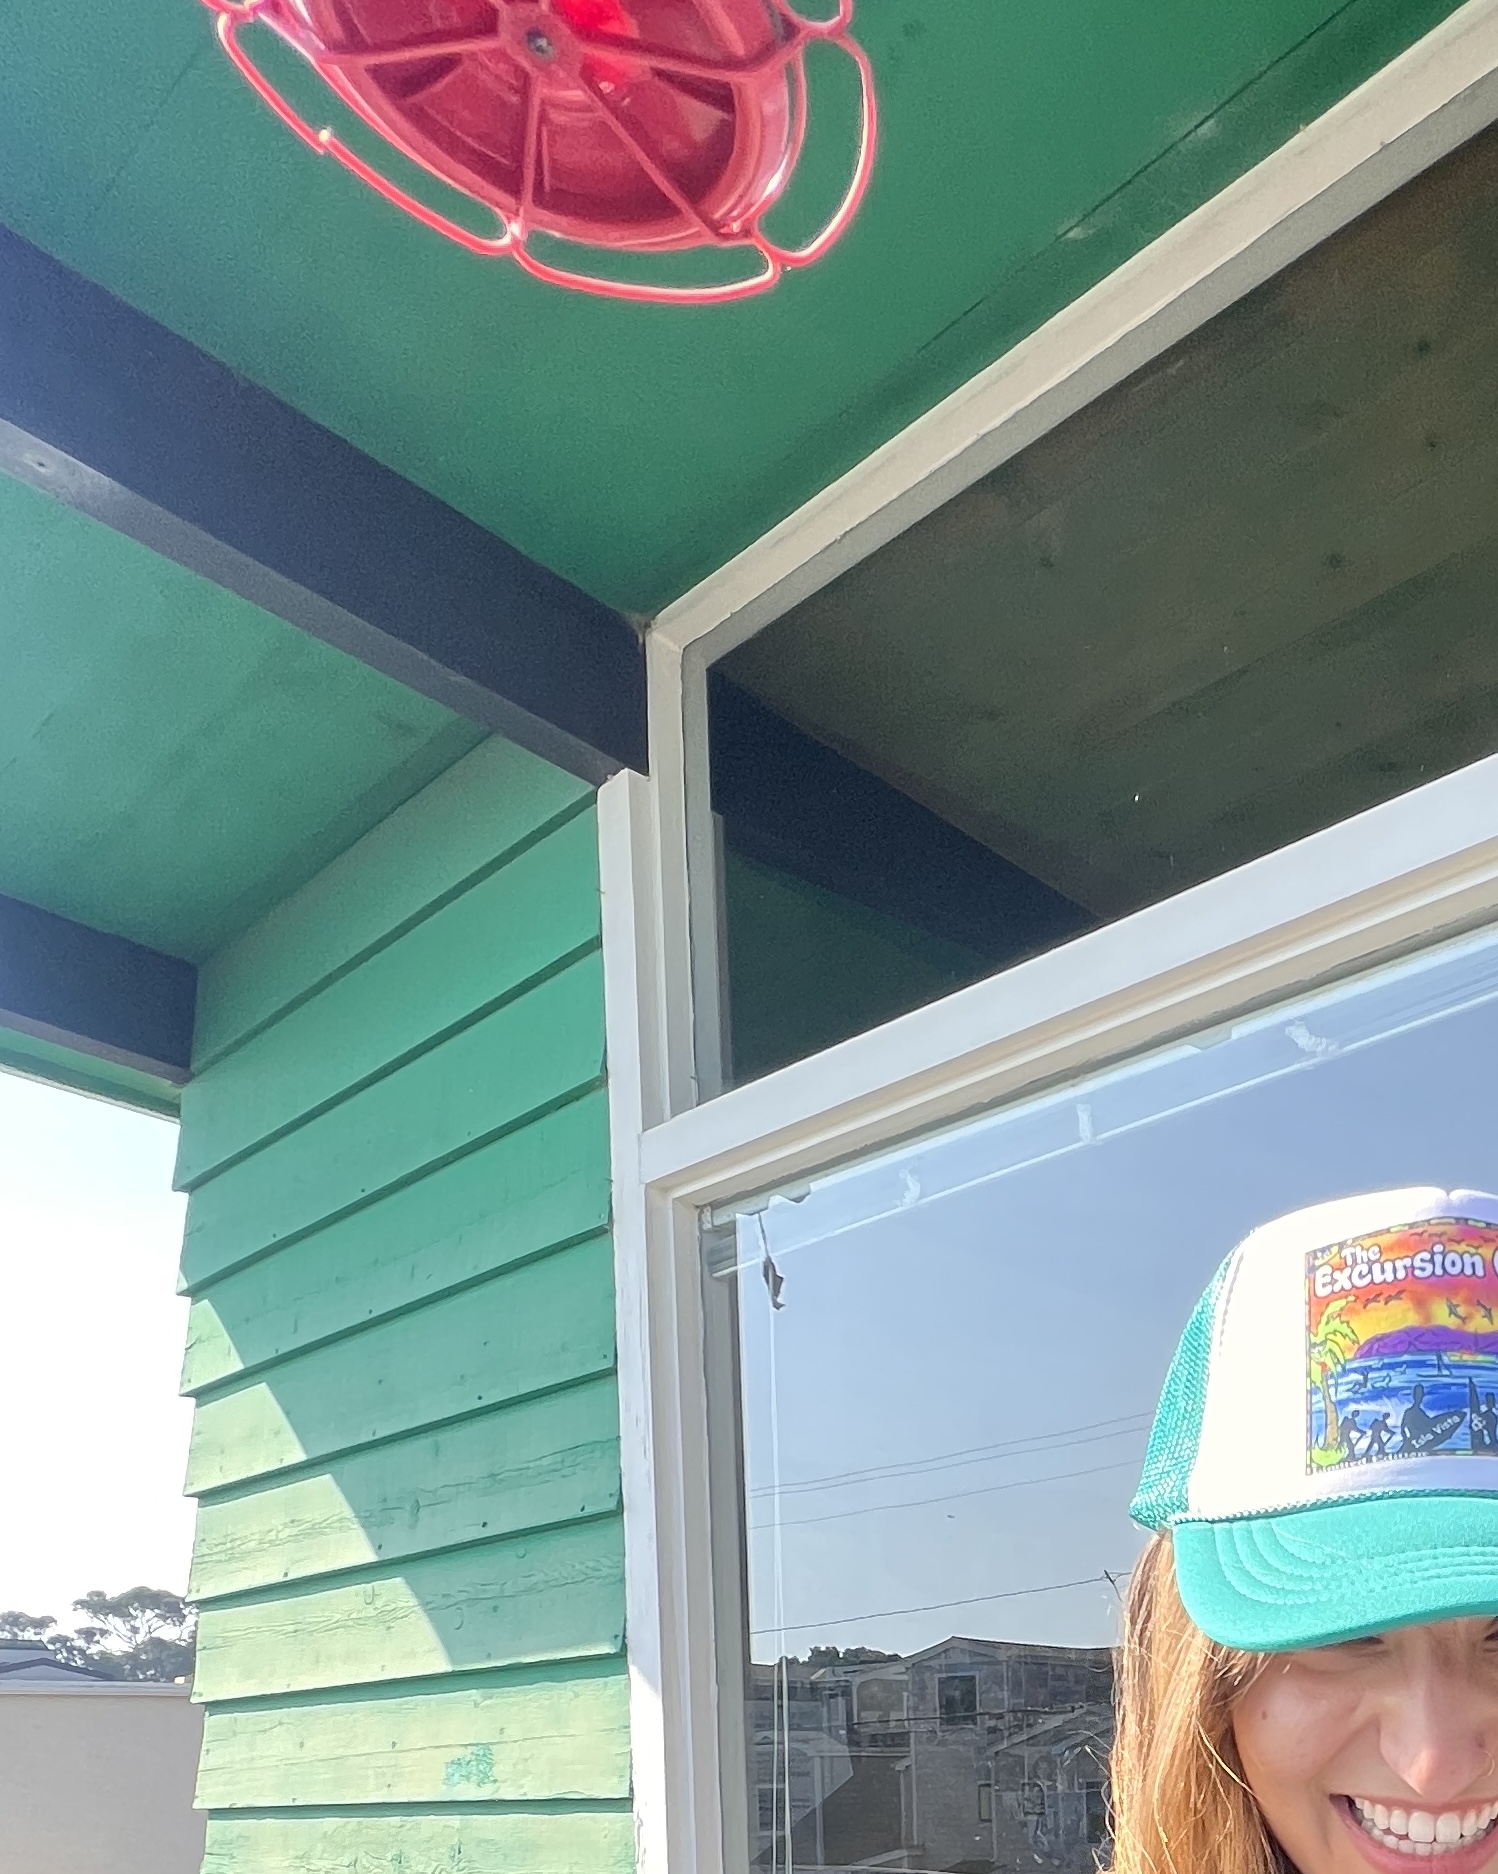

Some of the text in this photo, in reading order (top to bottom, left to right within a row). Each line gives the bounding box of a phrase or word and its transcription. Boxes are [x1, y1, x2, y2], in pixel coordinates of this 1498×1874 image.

[1313, 1242, 1486, 1298] Excursion
[1340, 1244, 1382, 1267] The
[1411, 1415, 1461, 1449] Isla Vista
